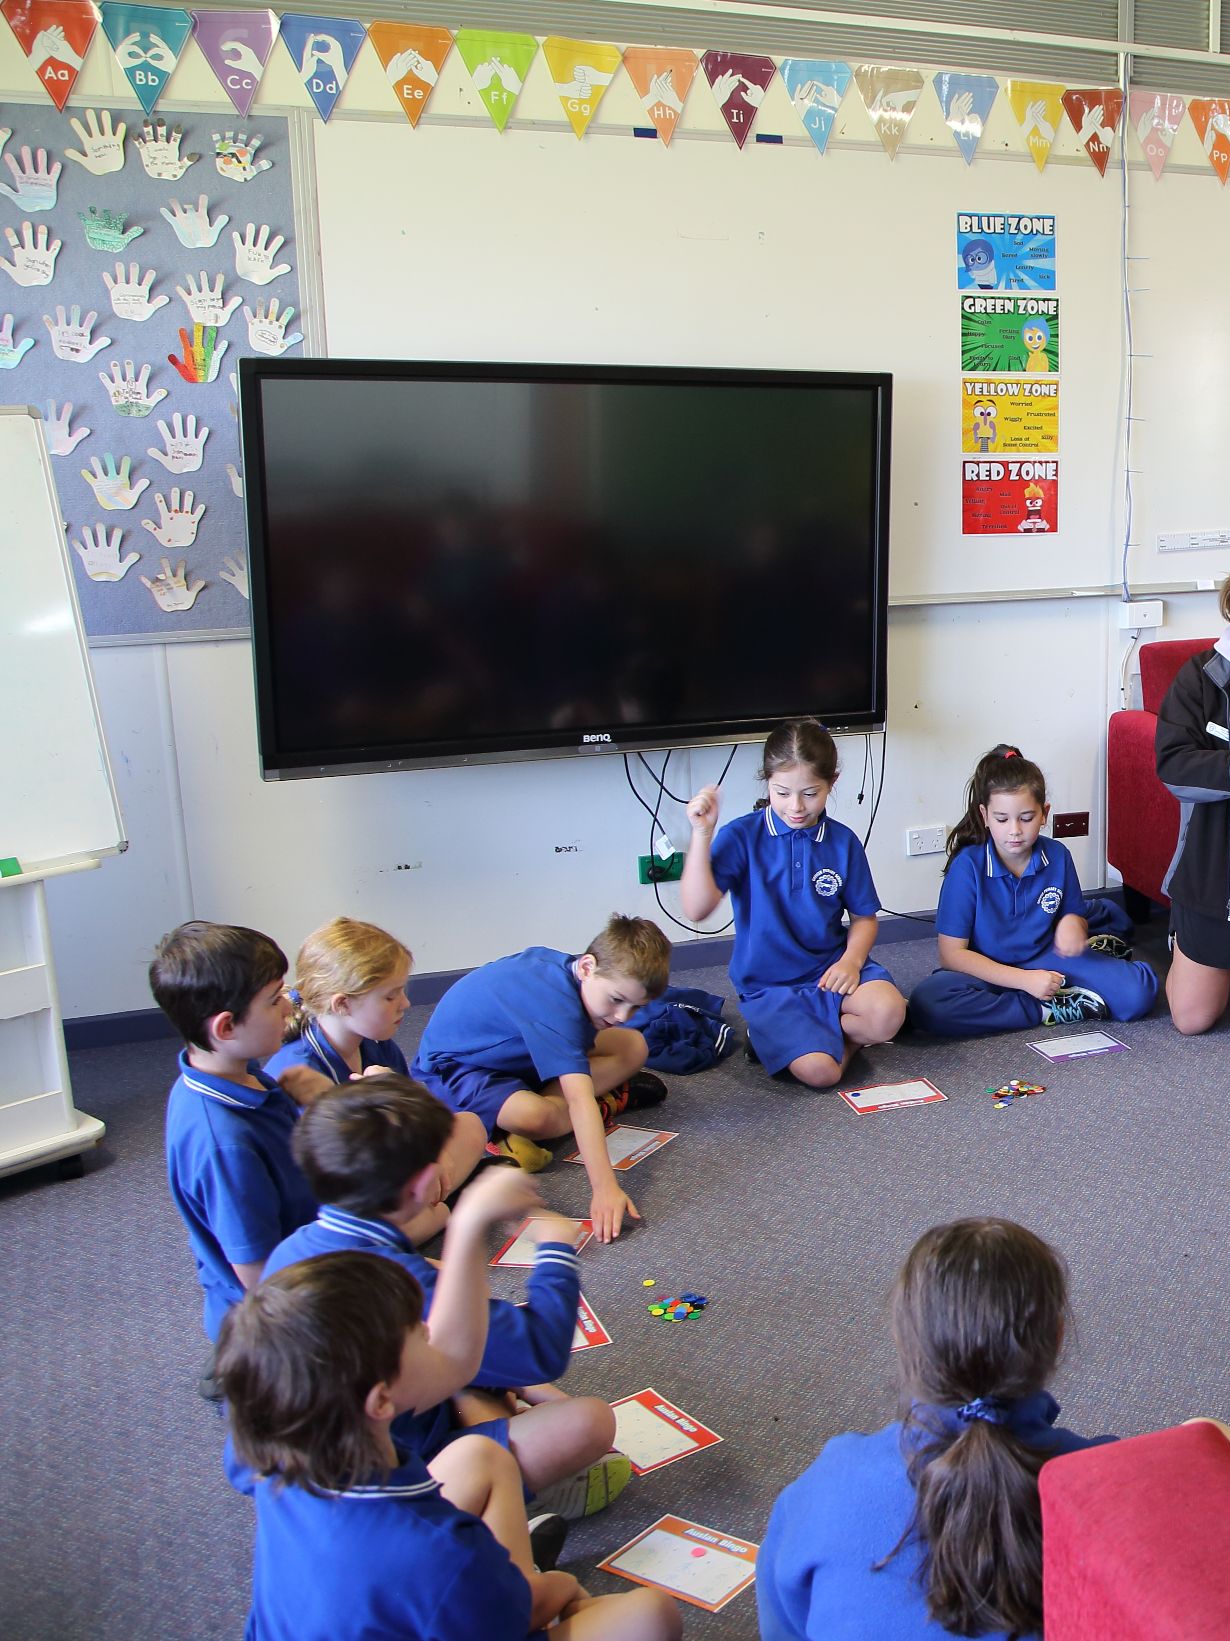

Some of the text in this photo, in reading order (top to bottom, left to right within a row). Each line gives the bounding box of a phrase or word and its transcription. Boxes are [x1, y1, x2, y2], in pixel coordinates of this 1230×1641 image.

[44, 65, 69, 81] Aa
[135, 72, 159, 87] Bb
[227, 75, 252, 90] Cc
[312, 79, 337, 94] Dd
[403, 85, 424, 99] Ee
[491, 91, 508, 104] Ff
[567, 100, 591, 116] Gg
[654, 106, 675, 120] Hh
[731, 109, 744, 123] Ii
[810, 119, 825, 132] Jj
[880, 123, 899, 136] Kk
[1029, 135, 1050, 149] Mm
[1089, 141, 1108, 153] Nn
[1147, 145, 1165, 157] Oo
[1213, 150, 1228, 163] Pp
[959, 215, 1054, 235] BLUE ZONE
[963, 298, 1057, 315] GREEN ZONE
[965, 382, 1057, 397] YELLOW ZONE
[965, 462, 1057, 481] RED ZONE
[684, 1528, 748, 1554] Auslan Bingo
